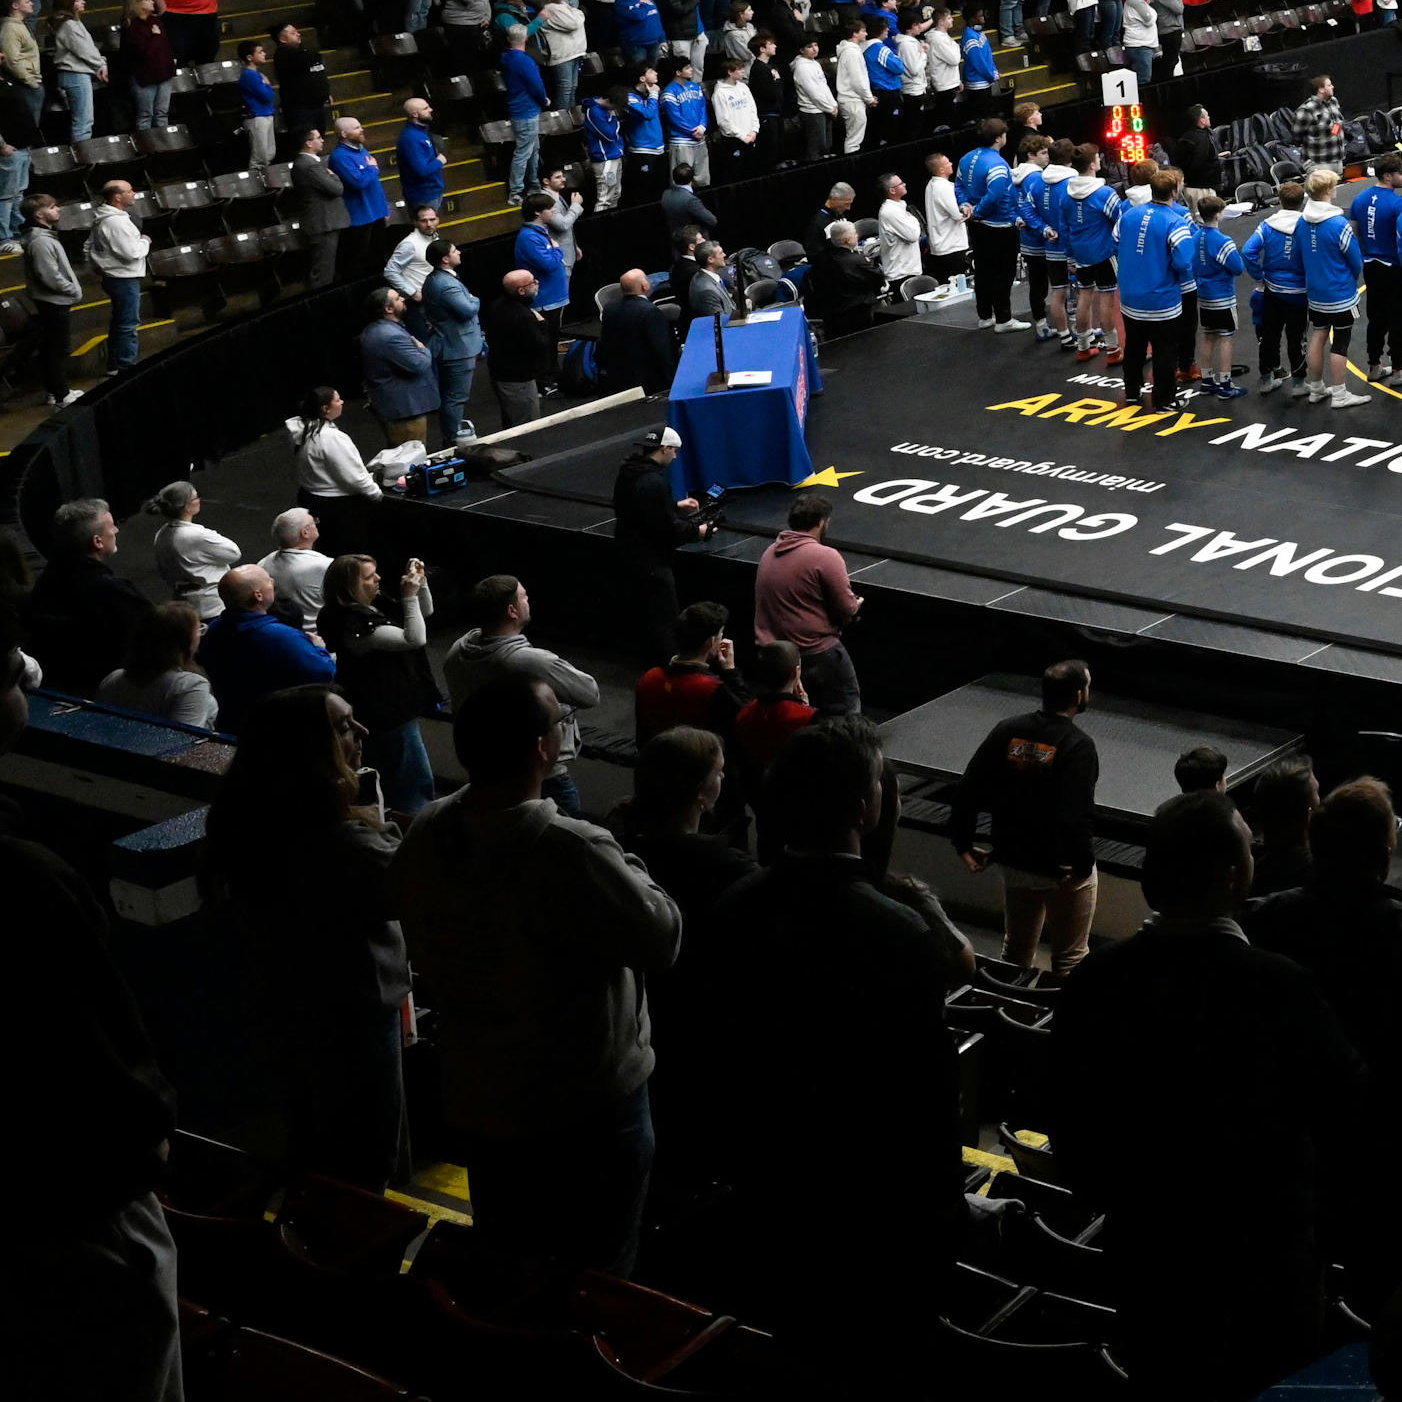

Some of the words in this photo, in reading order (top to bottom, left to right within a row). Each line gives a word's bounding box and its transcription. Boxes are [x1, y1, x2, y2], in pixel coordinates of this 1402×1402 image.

[1116, 80, 1125, 98] 1
[1112, 119, 1122, 132] 0
[1133, 118, 1143, 132] 0
[1113, 106, 1122, 119] 0
[1131, 105, 1140, 118] 0
[1136, 215, 1151, 254] DETROIT
[1367, 206, 1376, 240] DETROIT
[985, 392, 1232, 436] ARMY
[890, 441, 1167, 493] miarmyguard.com
[854, 479, 1138, 541] GUARD
